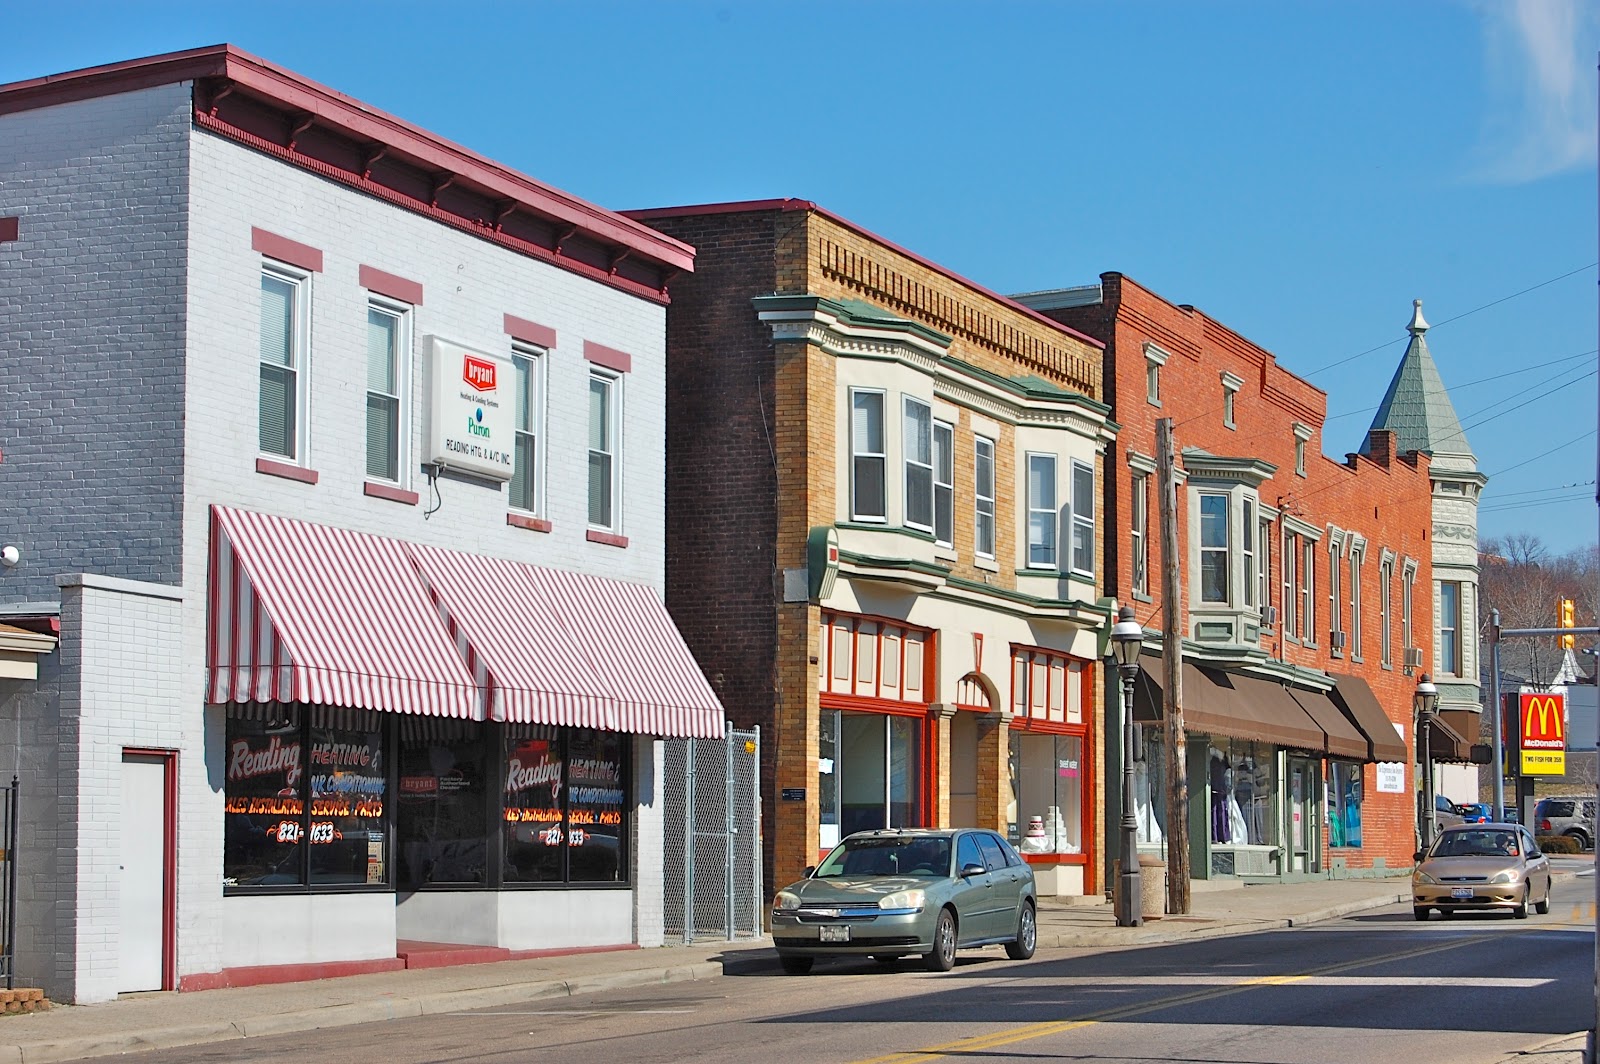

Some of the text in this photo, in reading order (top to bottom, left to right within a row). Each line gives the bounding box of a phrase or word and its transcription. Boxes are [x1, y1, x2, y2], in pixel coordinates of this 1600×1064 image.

[468, 360, 493, 384] bryant
[468, 416, 491, 438] Puron
[446, 439, 470, 455] READING
[483, 448, 488, 459] &
[489, 450, 500, 462] A/C
[311, 743, 370, 766] HEATING
[1523, 739, 1563, 748] McDonald's
[229, 736, 303, 785] Reading
[569, 759, 614, 780] HEATING
[326, 774, 386, 795] CONDITIONING
[405, 779, 433, 789] bryant
[506, 753, 563, 799] Reading
[578, 787, 625, 805] CONDITIONING
